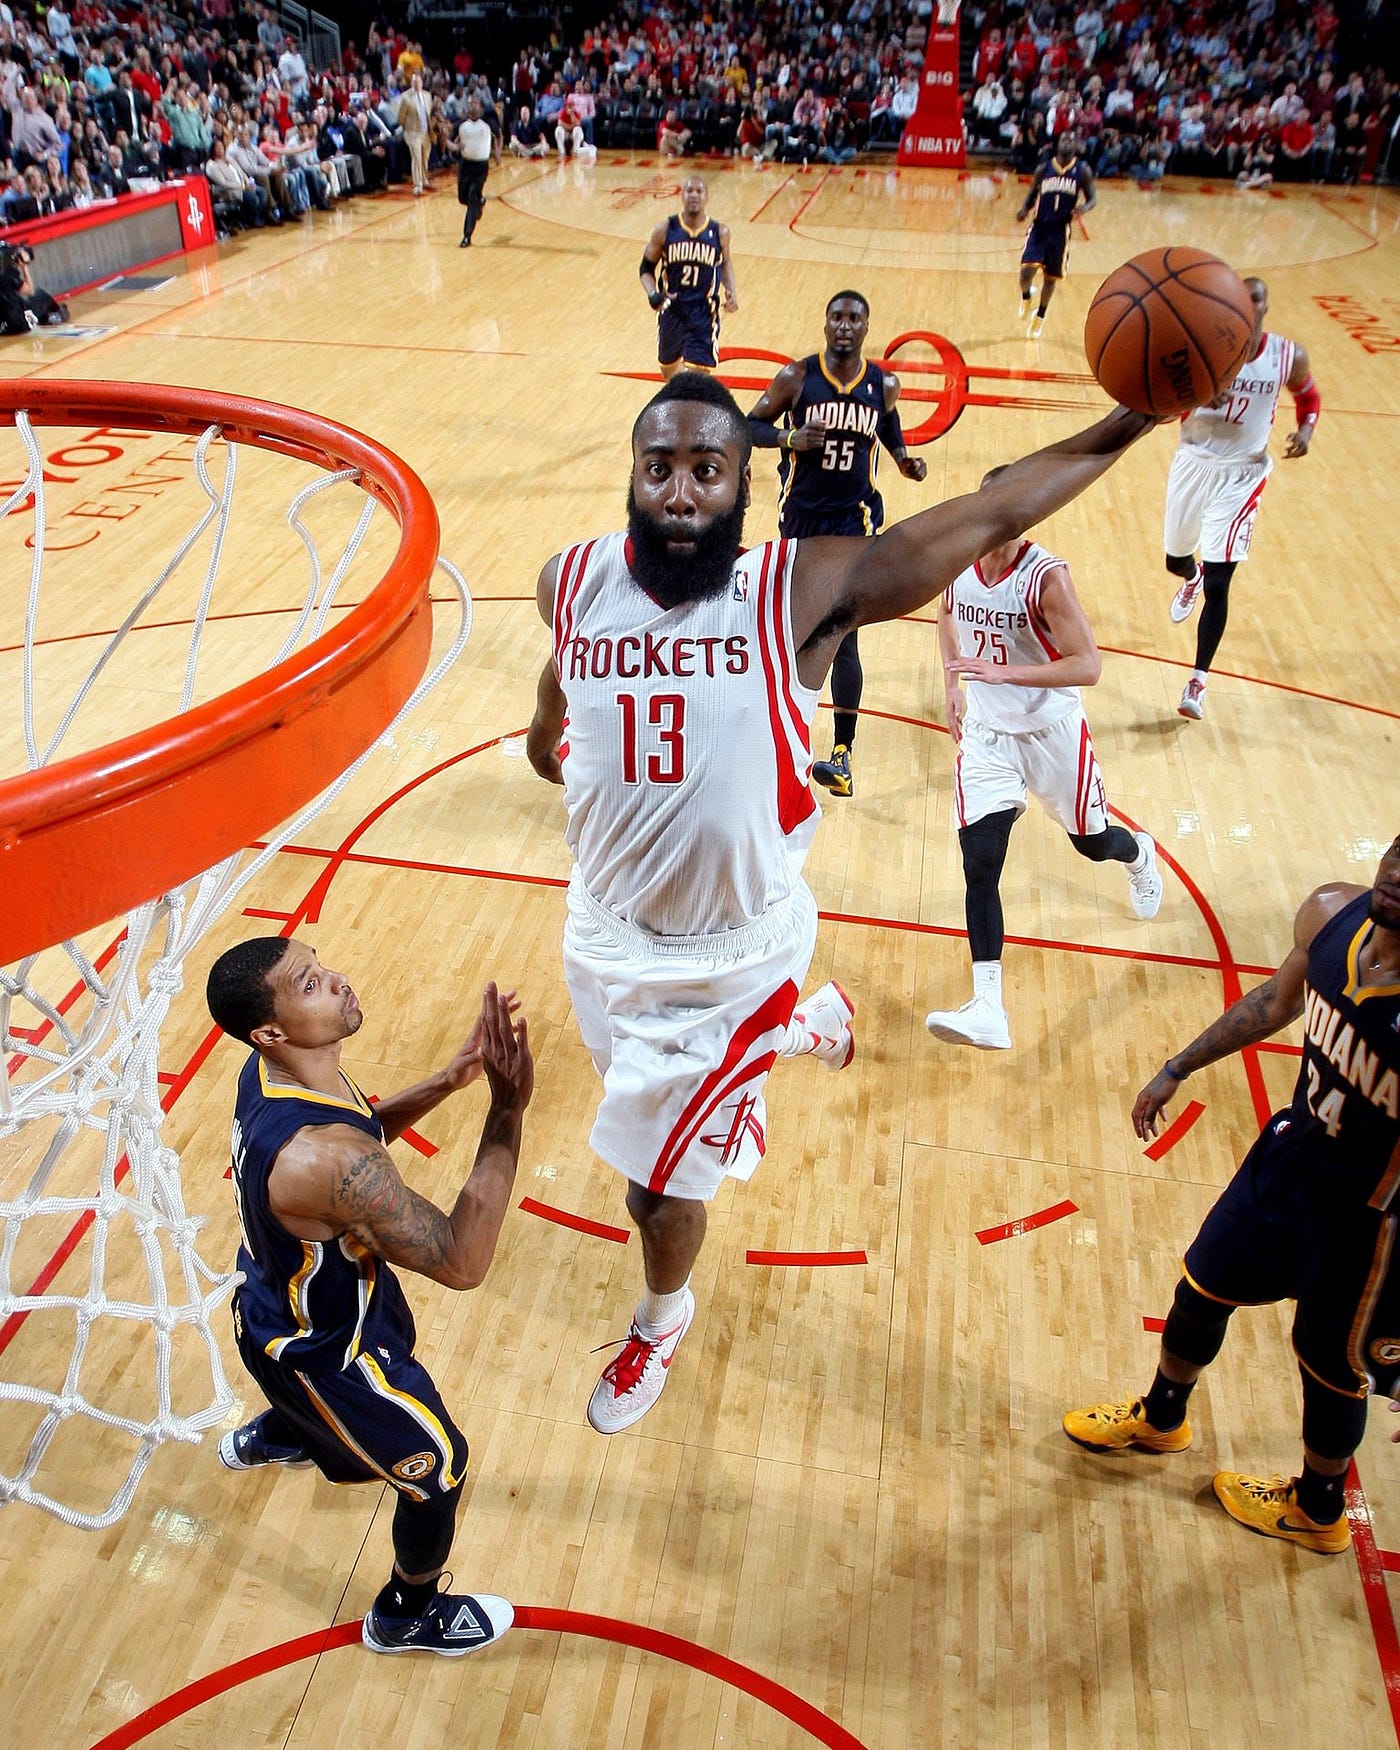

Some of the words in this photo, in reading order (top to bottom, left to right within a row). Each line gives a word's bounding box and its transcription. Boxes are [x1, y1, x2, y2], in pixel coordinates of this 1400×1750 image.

[918, 137, 942, 154] NBA
[945, 138, 961, 154] TV
[1054, 194, 1060, 211] 1
[668, 241, 716, 267] INDIANA
[680, 264, 699, 287] 21
[1228, 378, 1275, 395] CKETS
[805, 401, 879, 439] INDIANA
[1224, 395, 1251, 425] 12
[822, 440, 855, 471] 55
[956, 600, 1028, 631] ROCKETS
[568, 630, 750, 681] ROCKETS
[973, 629, 1008, 666] 25
[614, 691, 687, 785] 13
[1304, 979, 1399, 1119] NDIANA
[1307, 1058, 1346, 1138] 24
